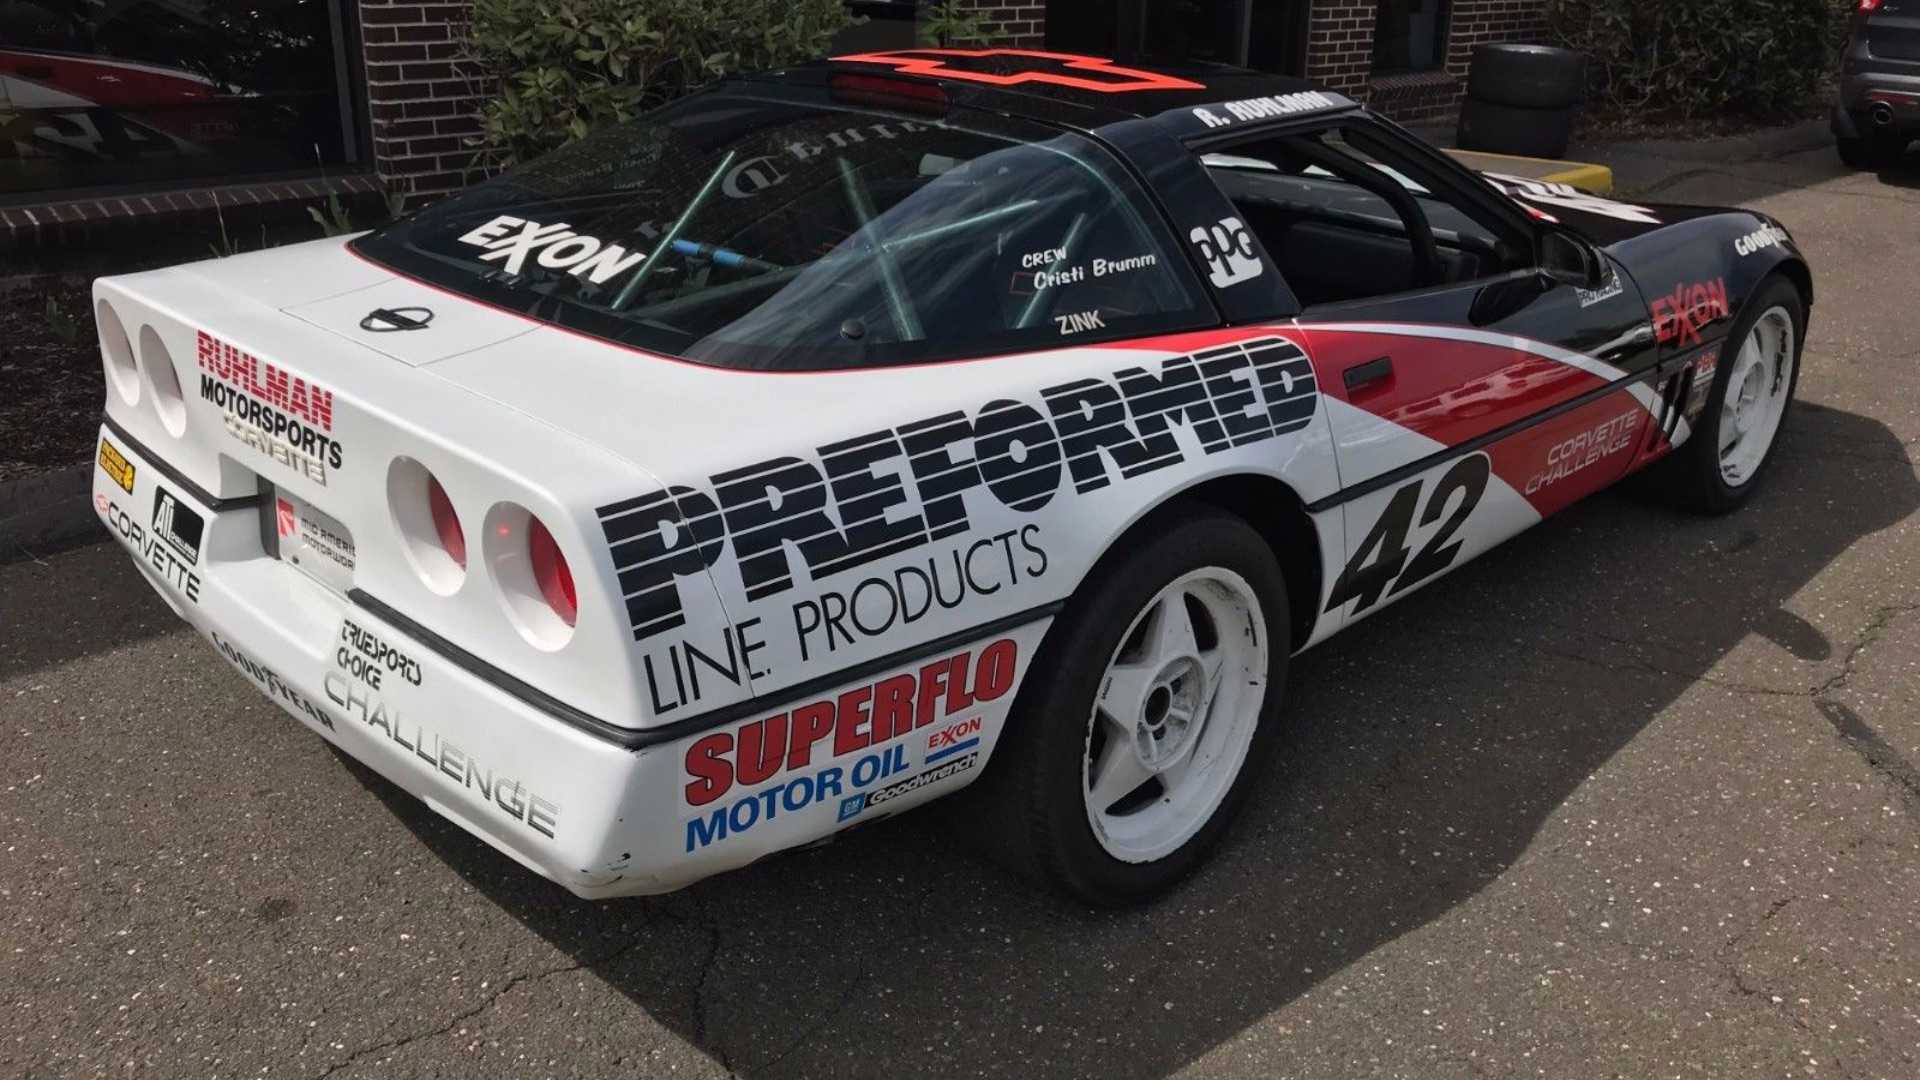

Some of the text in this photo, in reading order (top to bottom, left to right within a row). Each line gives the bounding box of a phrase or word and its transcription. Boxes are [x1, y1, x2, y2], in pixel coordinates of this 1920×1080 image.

[458, 215, 646, 284] EXXON
[1022, 246, 1067, 268] CREW
[1034, 253, 1156, 290] Cristi Brumm
[1055, 309, 1105, 335] ZINK
[1652, 277, 1728, 347] EXXON
[198, 329, 332, 432] RUHLMAN
[200, 374, 342, 470] MOTORSPORTS
[1547, 408, 1639, 465] CORVETTE
[595, 334, 1317, 640] PREFORMED
[1525, 434, 1632, 495] CHALLENGE
[108, 501, 200, 604] CORVETTE
[1323, 453, 1490, 617] 42
[793, 524, 1049, 661] PRODUCTS
[337, 647, 381, 691] CHOICE
[341, 618, 423, 686] TRUESPORTS
[323, 671, 562, 840] CHALLENGE
[685, 638, 1017, 807] SUPERFLO
[928, 717, 982, 749] EXXON
[686, 744, 910, 852] MOTOR OIL
[869, 753, 979, 805] Goodwrench
